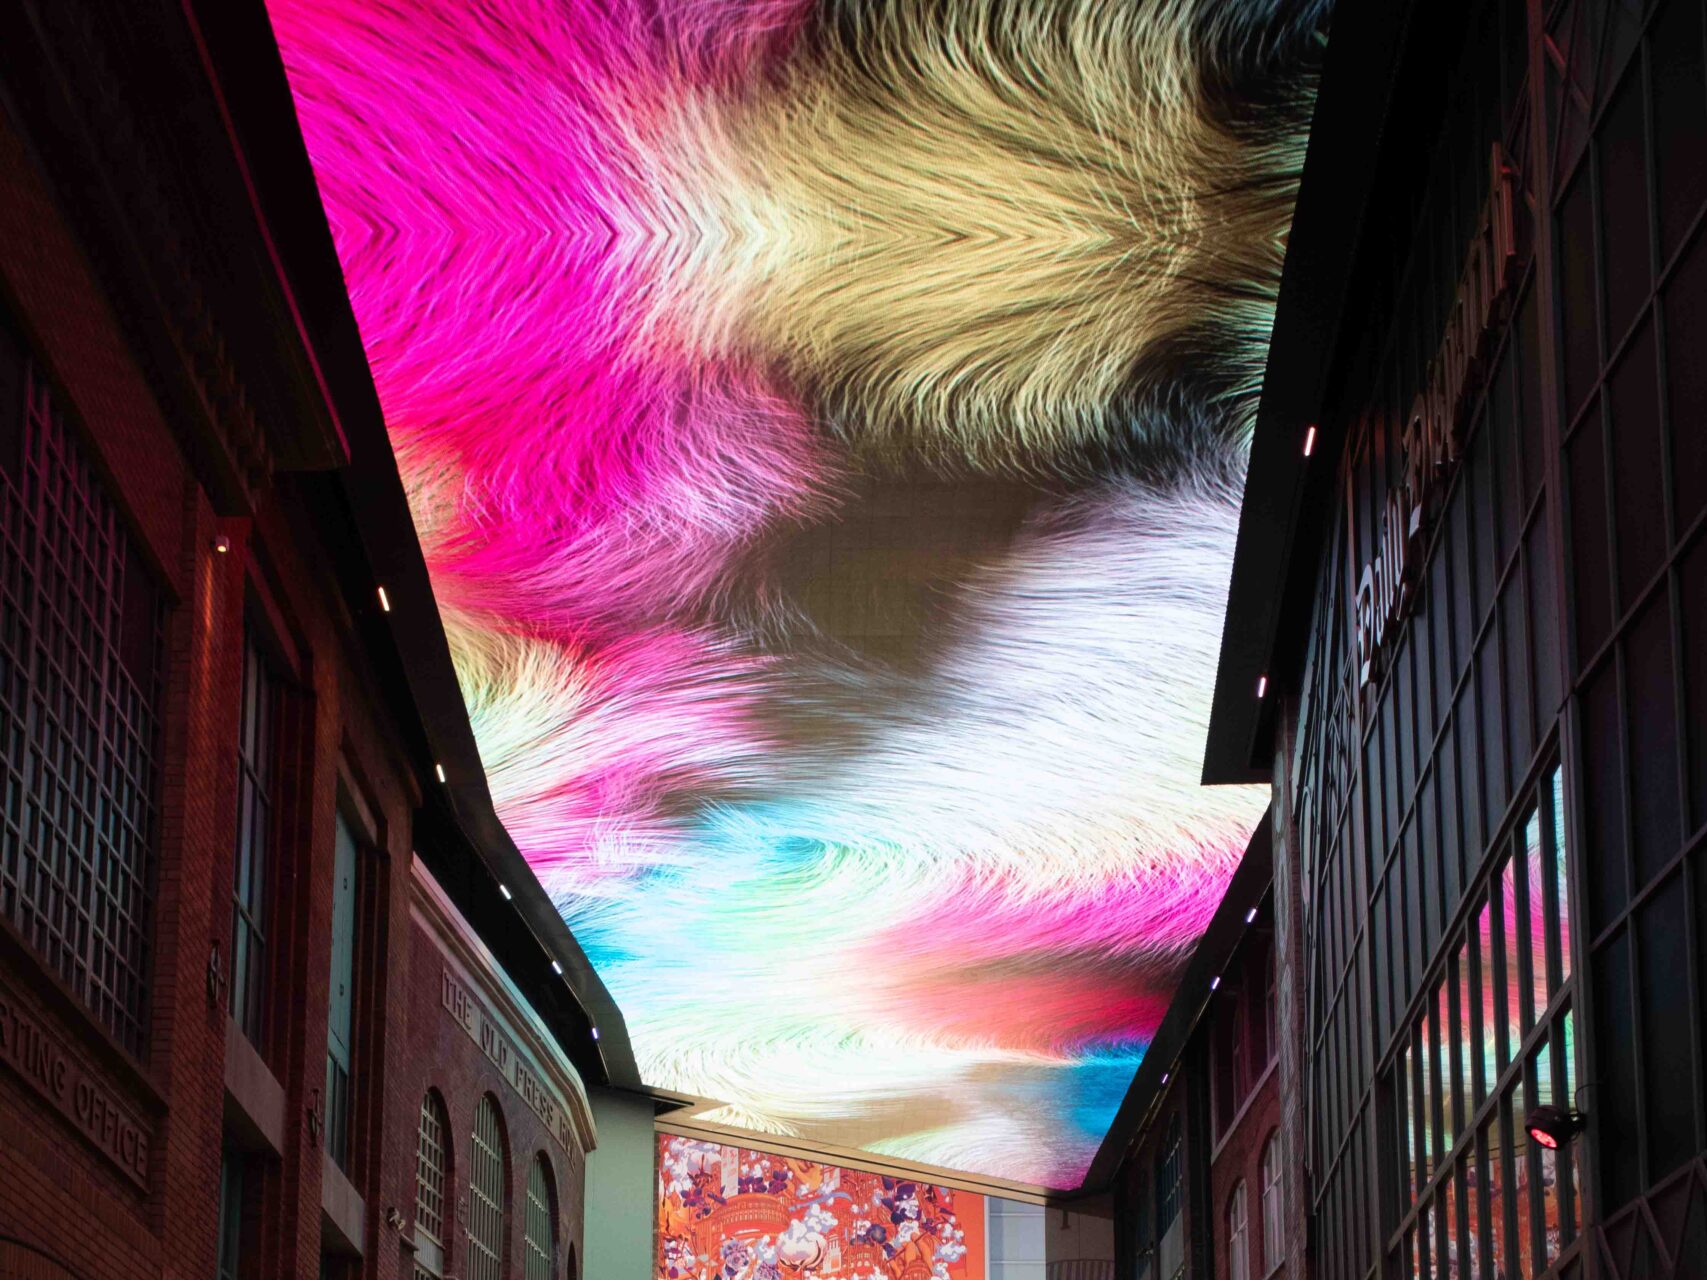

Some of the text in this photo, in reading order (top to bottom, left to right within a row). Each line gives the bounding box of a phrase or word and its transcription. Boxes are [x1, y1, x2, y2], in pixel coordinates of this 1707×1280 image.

[1356, 487, 1407, 688] Daily
[443, 974, 473, 1030] THE
[481, 1020, 508, 1071] OLD
[514, 1060, 554, 1125] PRESS
[74, 1081, 146, 1178] OFFICE
